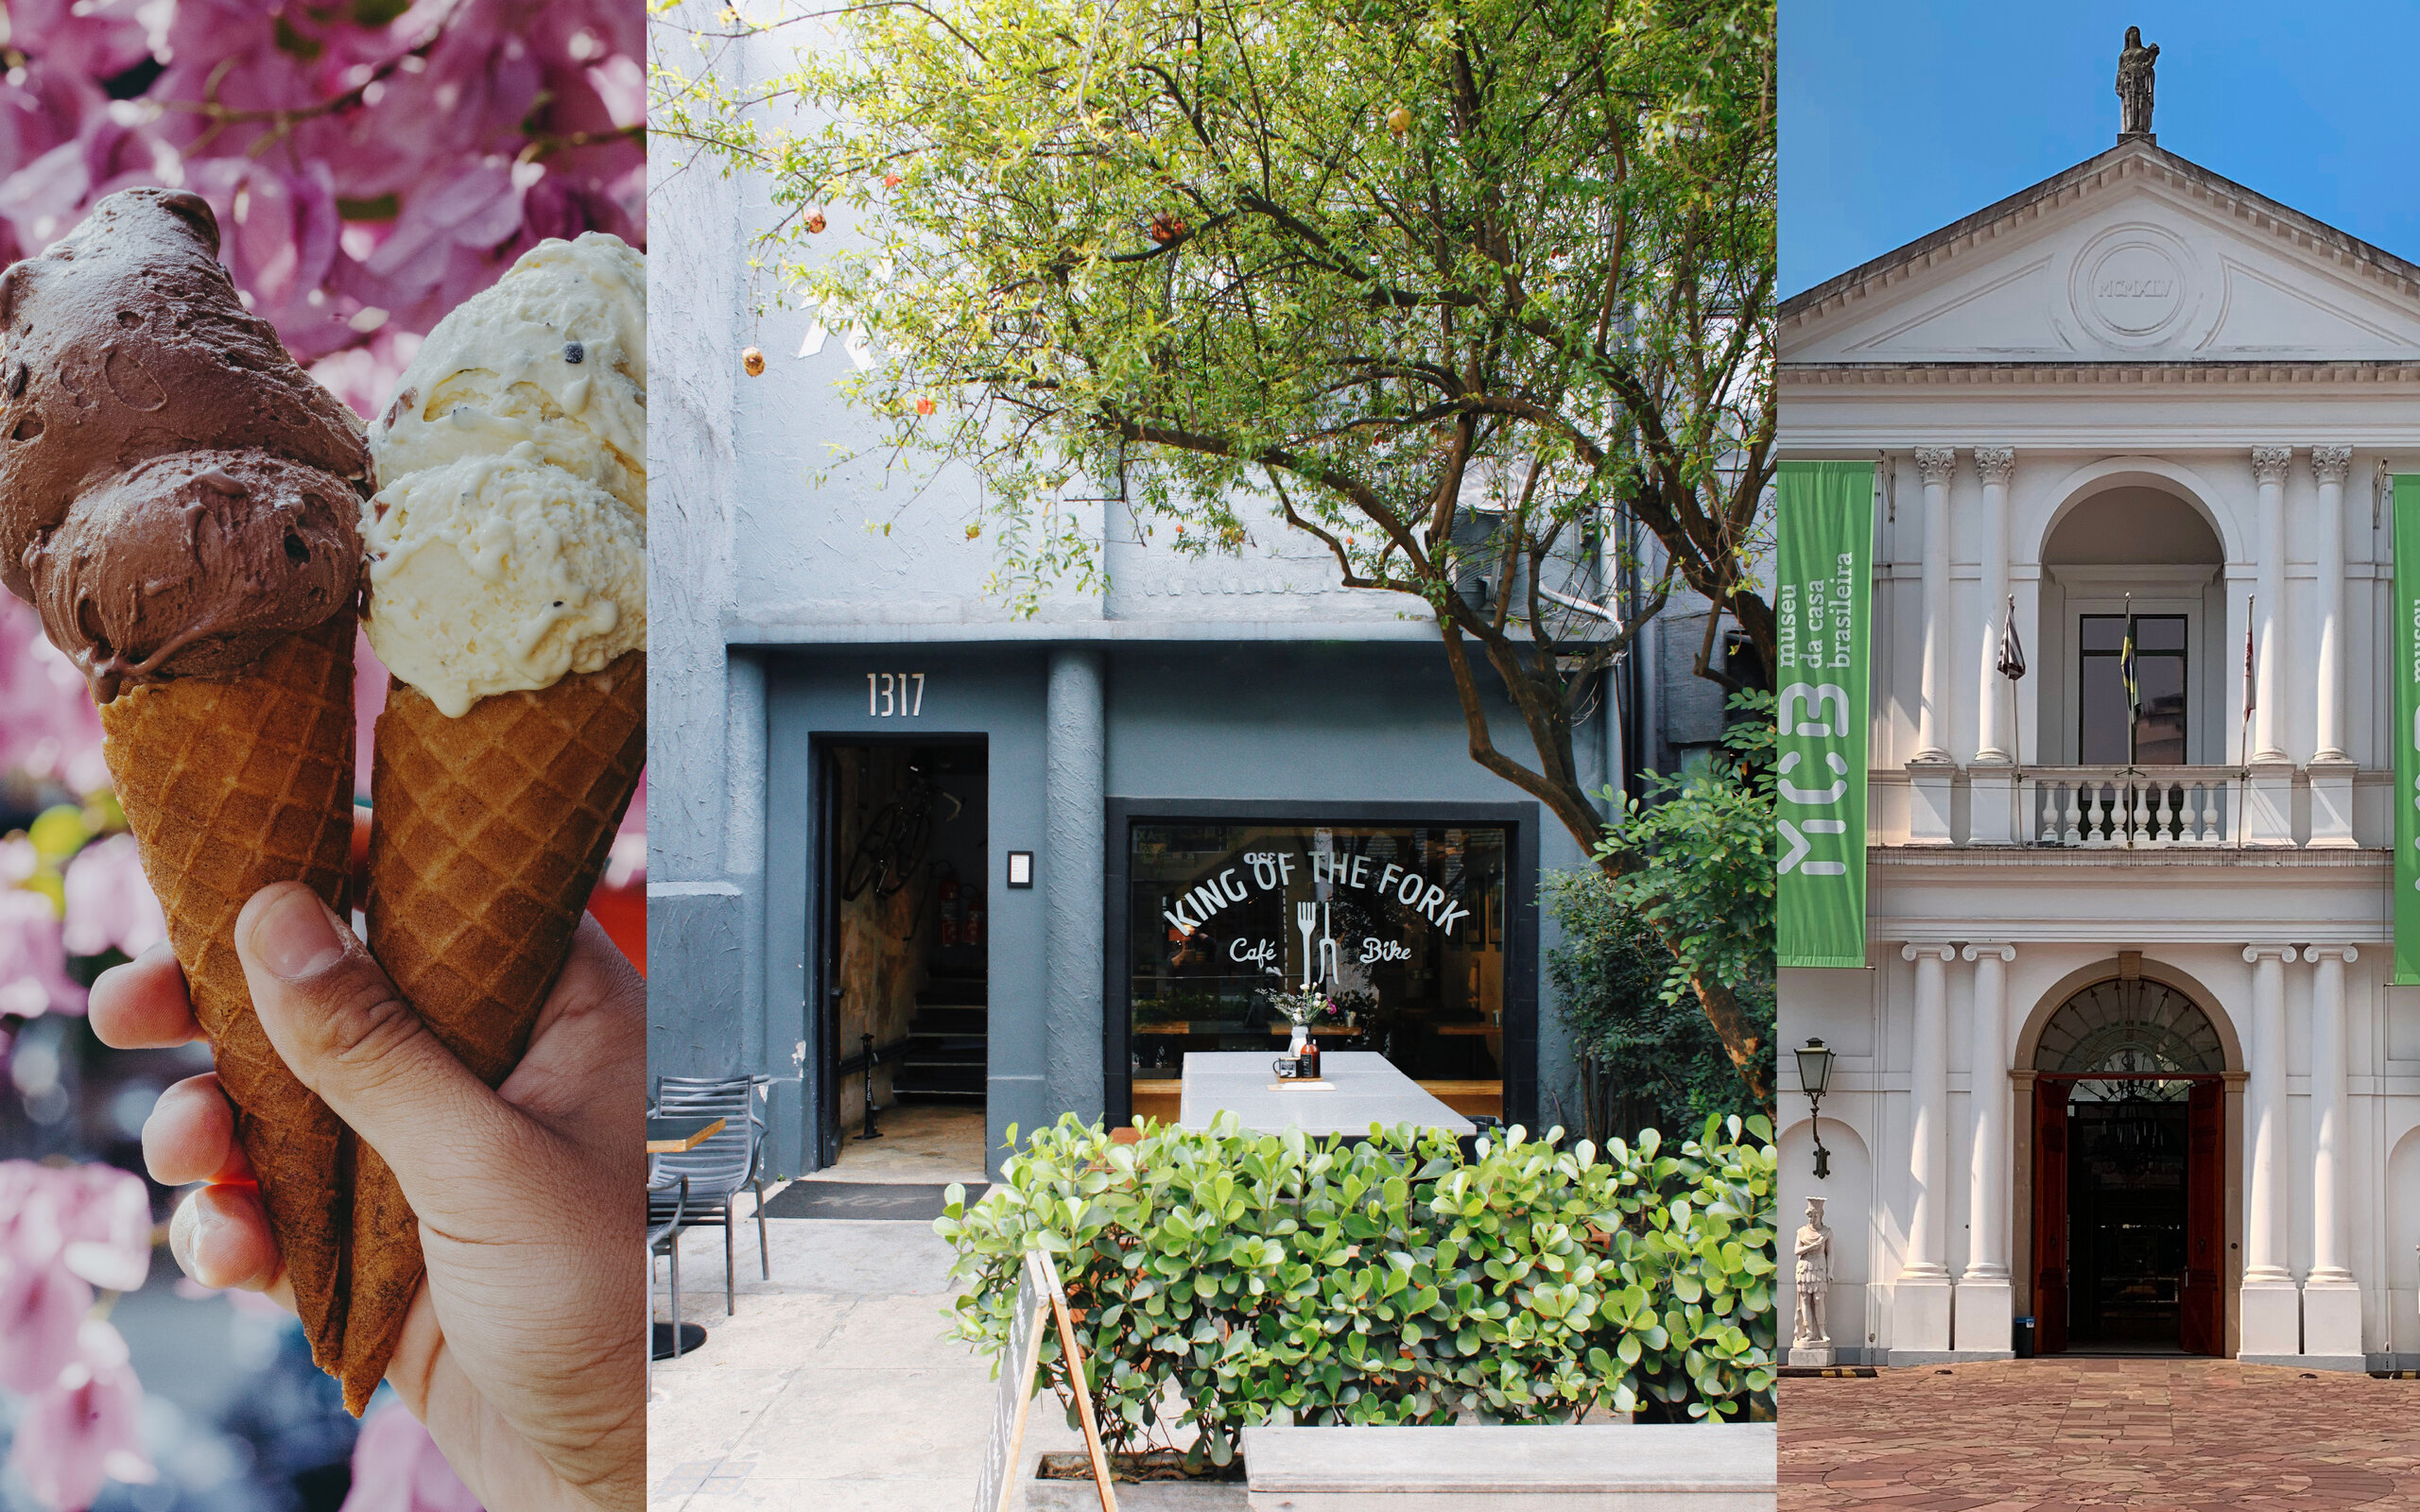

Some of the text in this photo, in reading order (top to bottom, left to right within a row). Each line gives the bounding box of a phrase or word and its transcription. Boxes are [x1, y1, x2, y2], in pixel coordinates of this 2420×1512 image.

[1780, 584, 1797, 668] museu
[1800, 579, 1824, 669] da casa
[1826, 551, 1853, 669] brasileira
[867, 673, 925, 717] 1317
[1164, 850, 1471, 936] KING OF THE FORK
[1229, 937, 1411, 969] Café Bike
